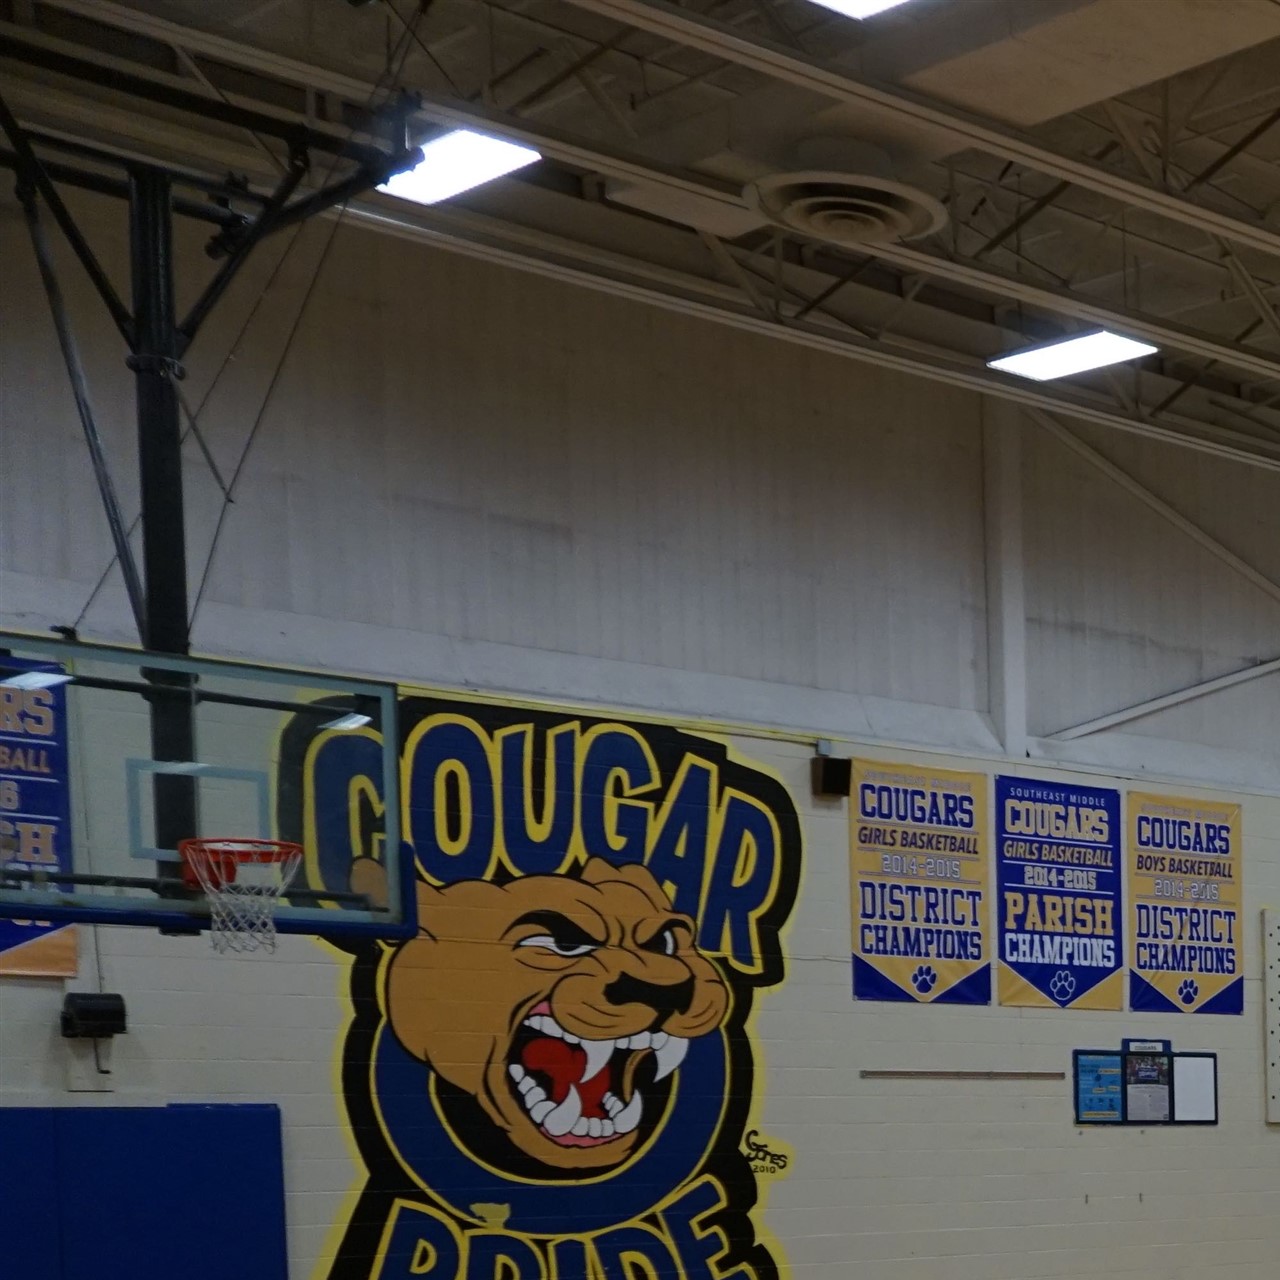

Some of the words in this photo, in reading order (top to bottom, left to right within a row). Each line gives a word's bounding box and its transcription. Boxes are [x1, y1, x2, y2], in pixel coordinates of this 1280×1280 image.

[860, 783, 974, 828] COUGARS
[1009, 787, 1066, 802] SOUTHEAST
[1069, 795, 1105, 807] MIDDLE
[1004, 799, 1109, 843] COUGARS
[1137, 815, 1230, 854] COUGARS
[303, 712, 781, 976] COUGAR
[858, 826, 896, 847] GIRLS
[900, 831, 979, 854] BASKETBALL
[1003, 840, 1039, 860] GIRLS
[1041, 844, 1113, 867] BASKETBALL
[882, 855, 961, 878] 2014-2015
[1023, 865, 1097, 890] 2014-2015
[1136, 854, 1166, 872] BOYS
[1168, 857, 1233, 878] BASKETBALL
[859, 881, 982, 927] DISTRICT
[1154, 879, 1219, 900] 2014-2015
[1004, 891, 1114, 936] PARISH
[1136, 904, 1236, 944] DISTRICT
[860, 923, 982, 960] CHAMPIONS
[1004, 932, 1115, 968] CHAMPIONS
[1136, 942, 1236, 974] CHAMPIONS
[752, 1164, 776, 1174] 2010
